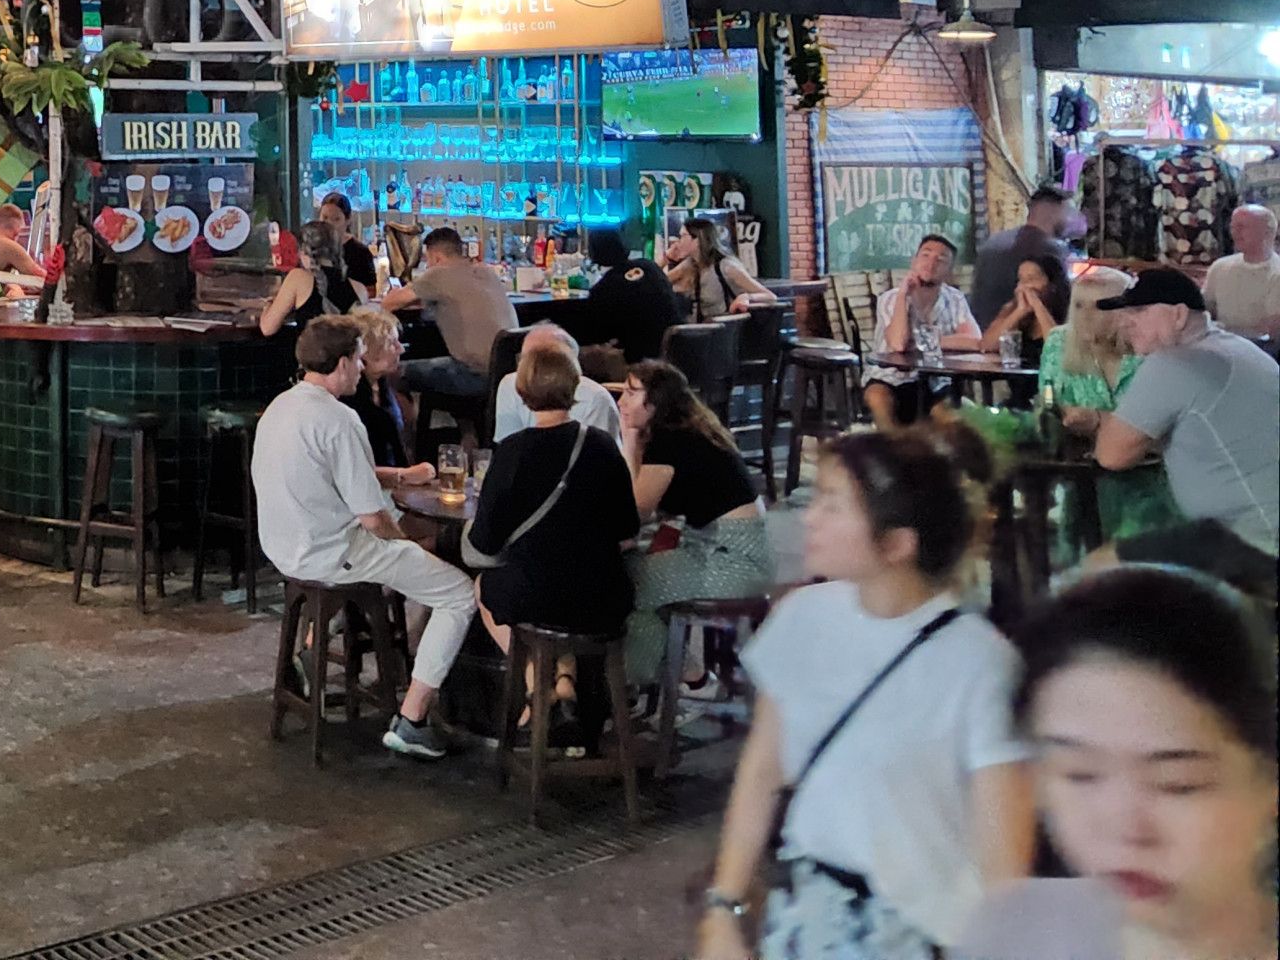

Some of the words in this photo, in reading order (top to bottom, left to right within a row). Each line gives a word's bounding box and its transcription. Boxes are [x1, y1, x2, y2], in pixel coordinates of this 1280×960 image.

[124, 120, 188, 151] IRISH
[195, 120, 241, 150] BAR
[824, 166, 972, 227] MULLIGANS
